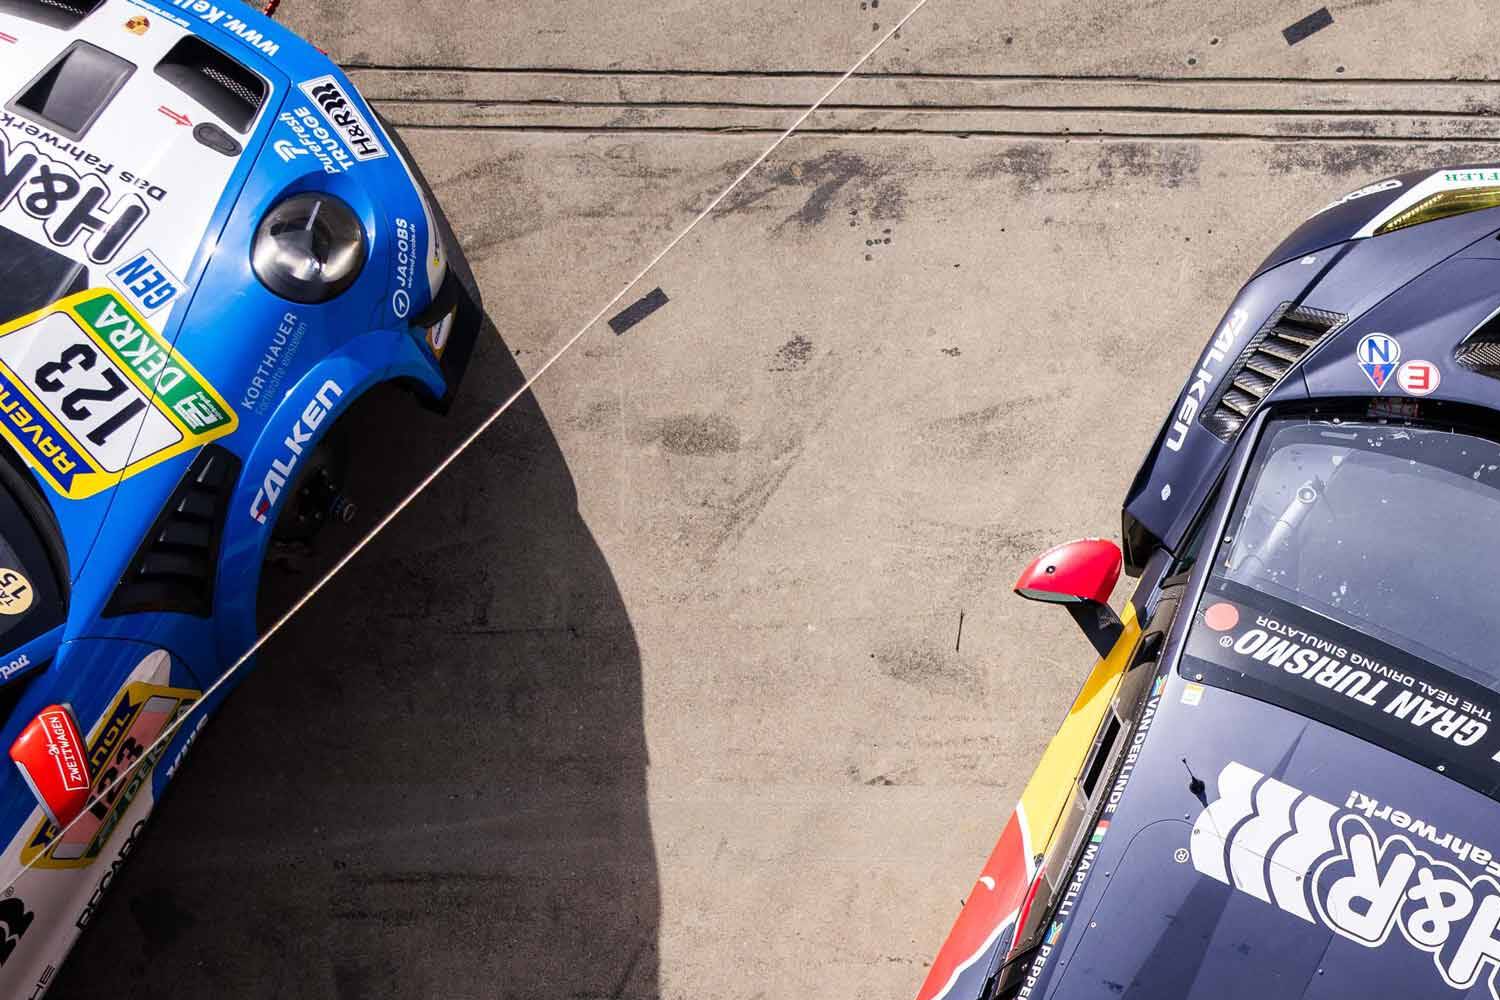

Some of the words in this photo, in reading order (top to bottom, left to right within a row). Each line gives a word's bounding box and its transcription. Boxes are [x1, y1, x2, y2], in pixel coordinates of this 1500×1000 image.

[395, 218, 409, 287] JACOBS
[94, 300, 186, 396] DEKRA
[241, 311, 298, 410] KORTHAUER
[1166, 308, 1249, 452] FALKEN
[35, 343, 147, 447] 123
[249, 379, 344, 525] FALKEN
[1233, 628, 1389, 706] TURISMO
[1255, 615, 1347, 659] SIMULATOR
[1350, 654, 1416, 687] DRIVING
[1138, 695, 1161, 731] VAN
[1382, 689, 1489, 747] GRAN
[1417, 680, 1460, 706] REAL
[1460, 701, 1492, 722] THE
[50, 716, 83, 783] ZWEITWAGEN
[1127, 732, 1147, 763] DER
[1104, 764, 1134, 814] LINDE
[1058, 842, 1099, 917] MAPELLI
